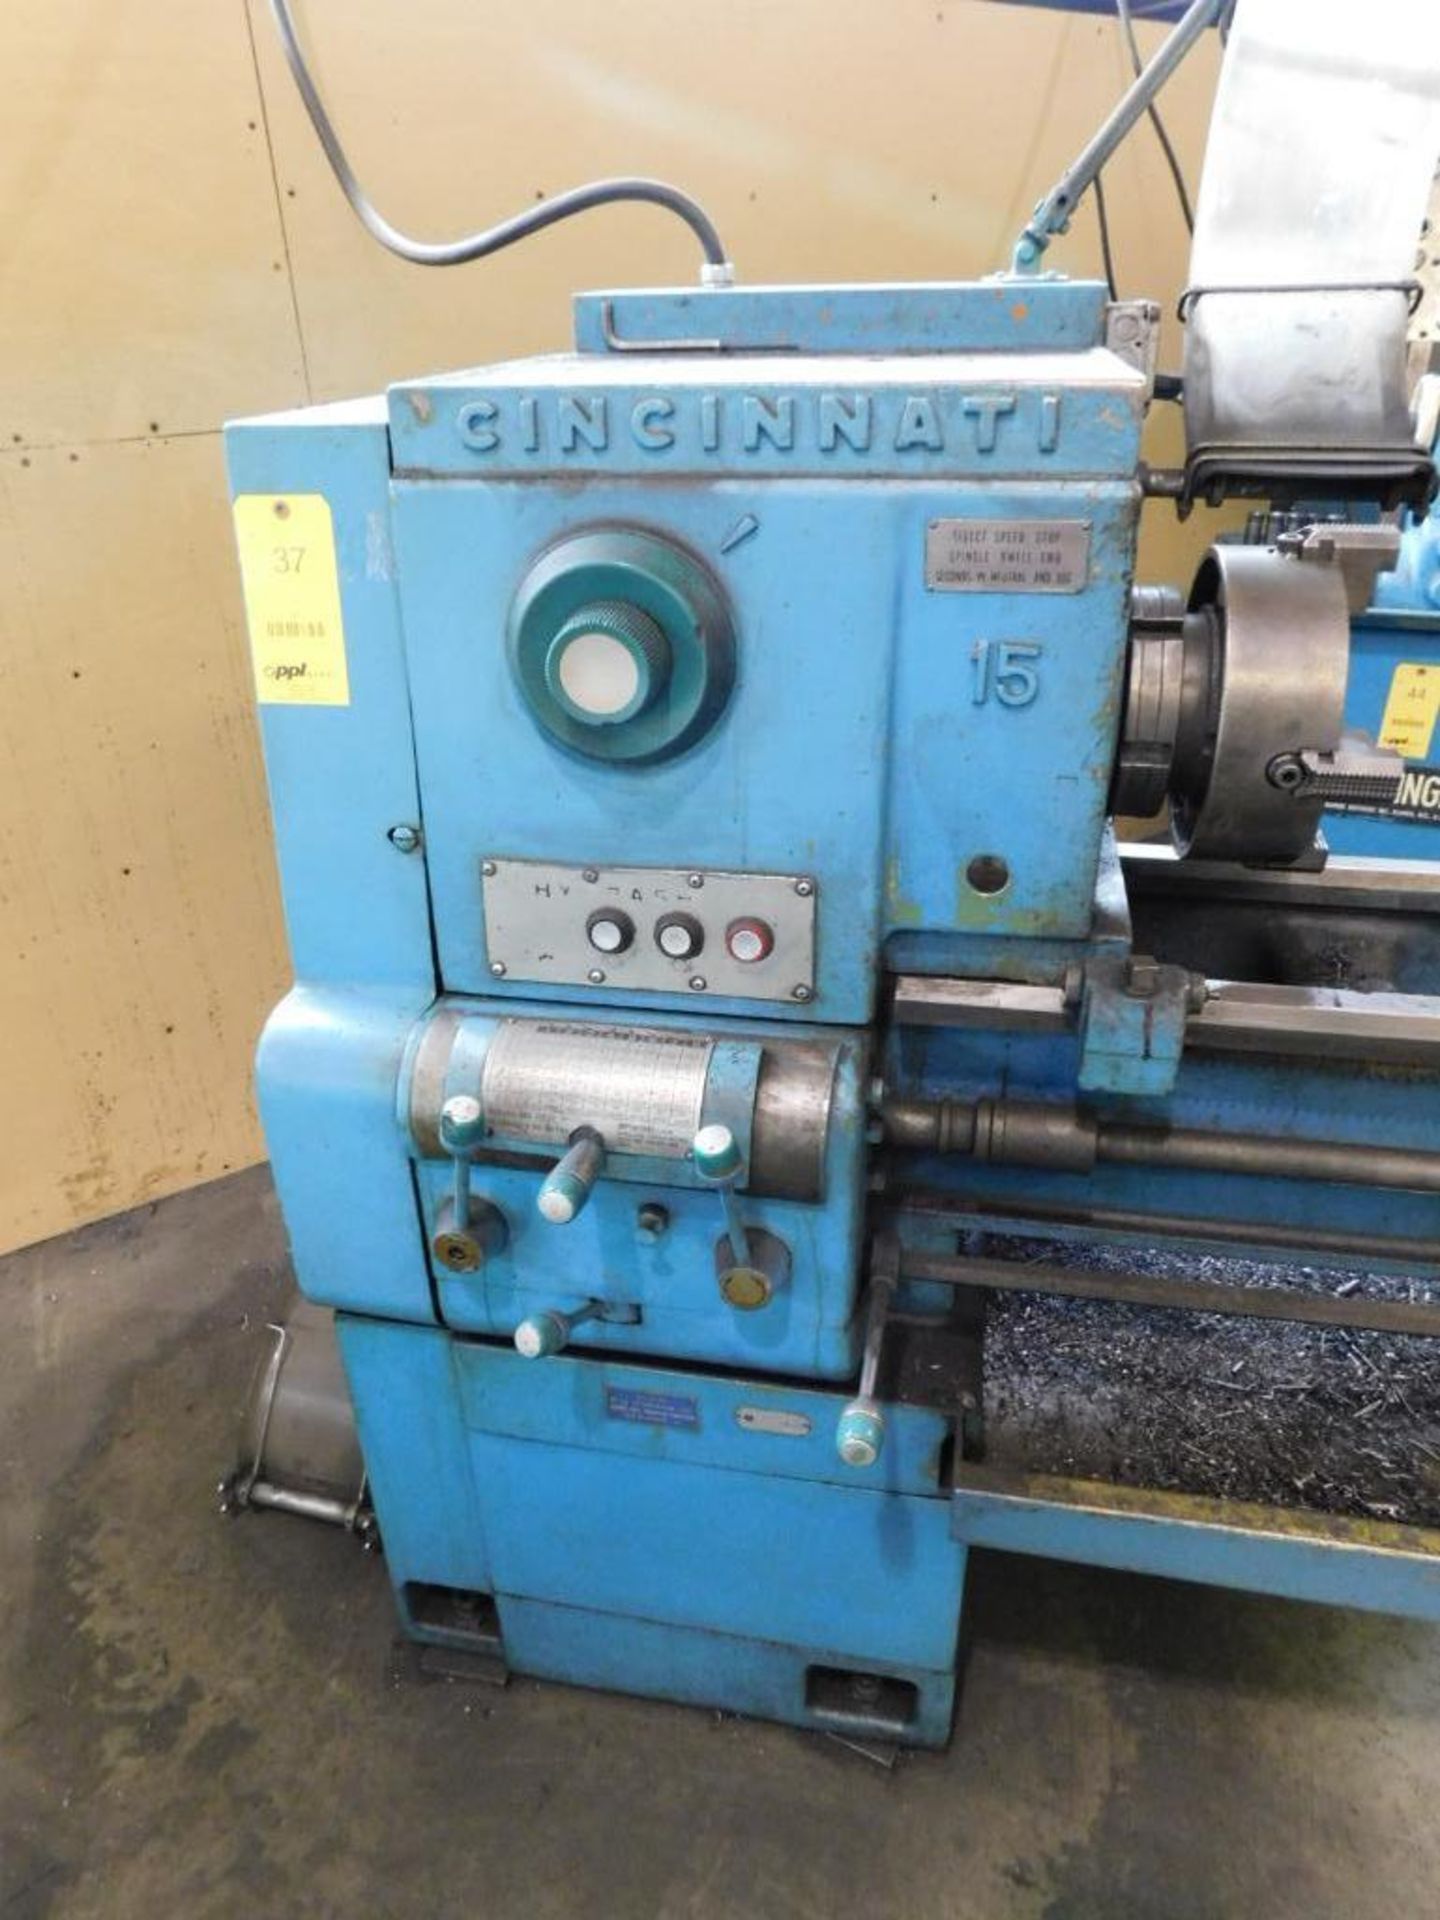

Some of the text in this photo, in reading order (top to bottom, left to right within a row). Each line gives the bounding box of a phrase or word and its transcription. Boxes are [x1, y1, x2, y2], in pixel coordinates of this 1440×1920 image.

[456, 396, 1061, 453] CINCINNATI
[273, 546, 307, 573] 37
[969, 638, 1042, 708] 15
